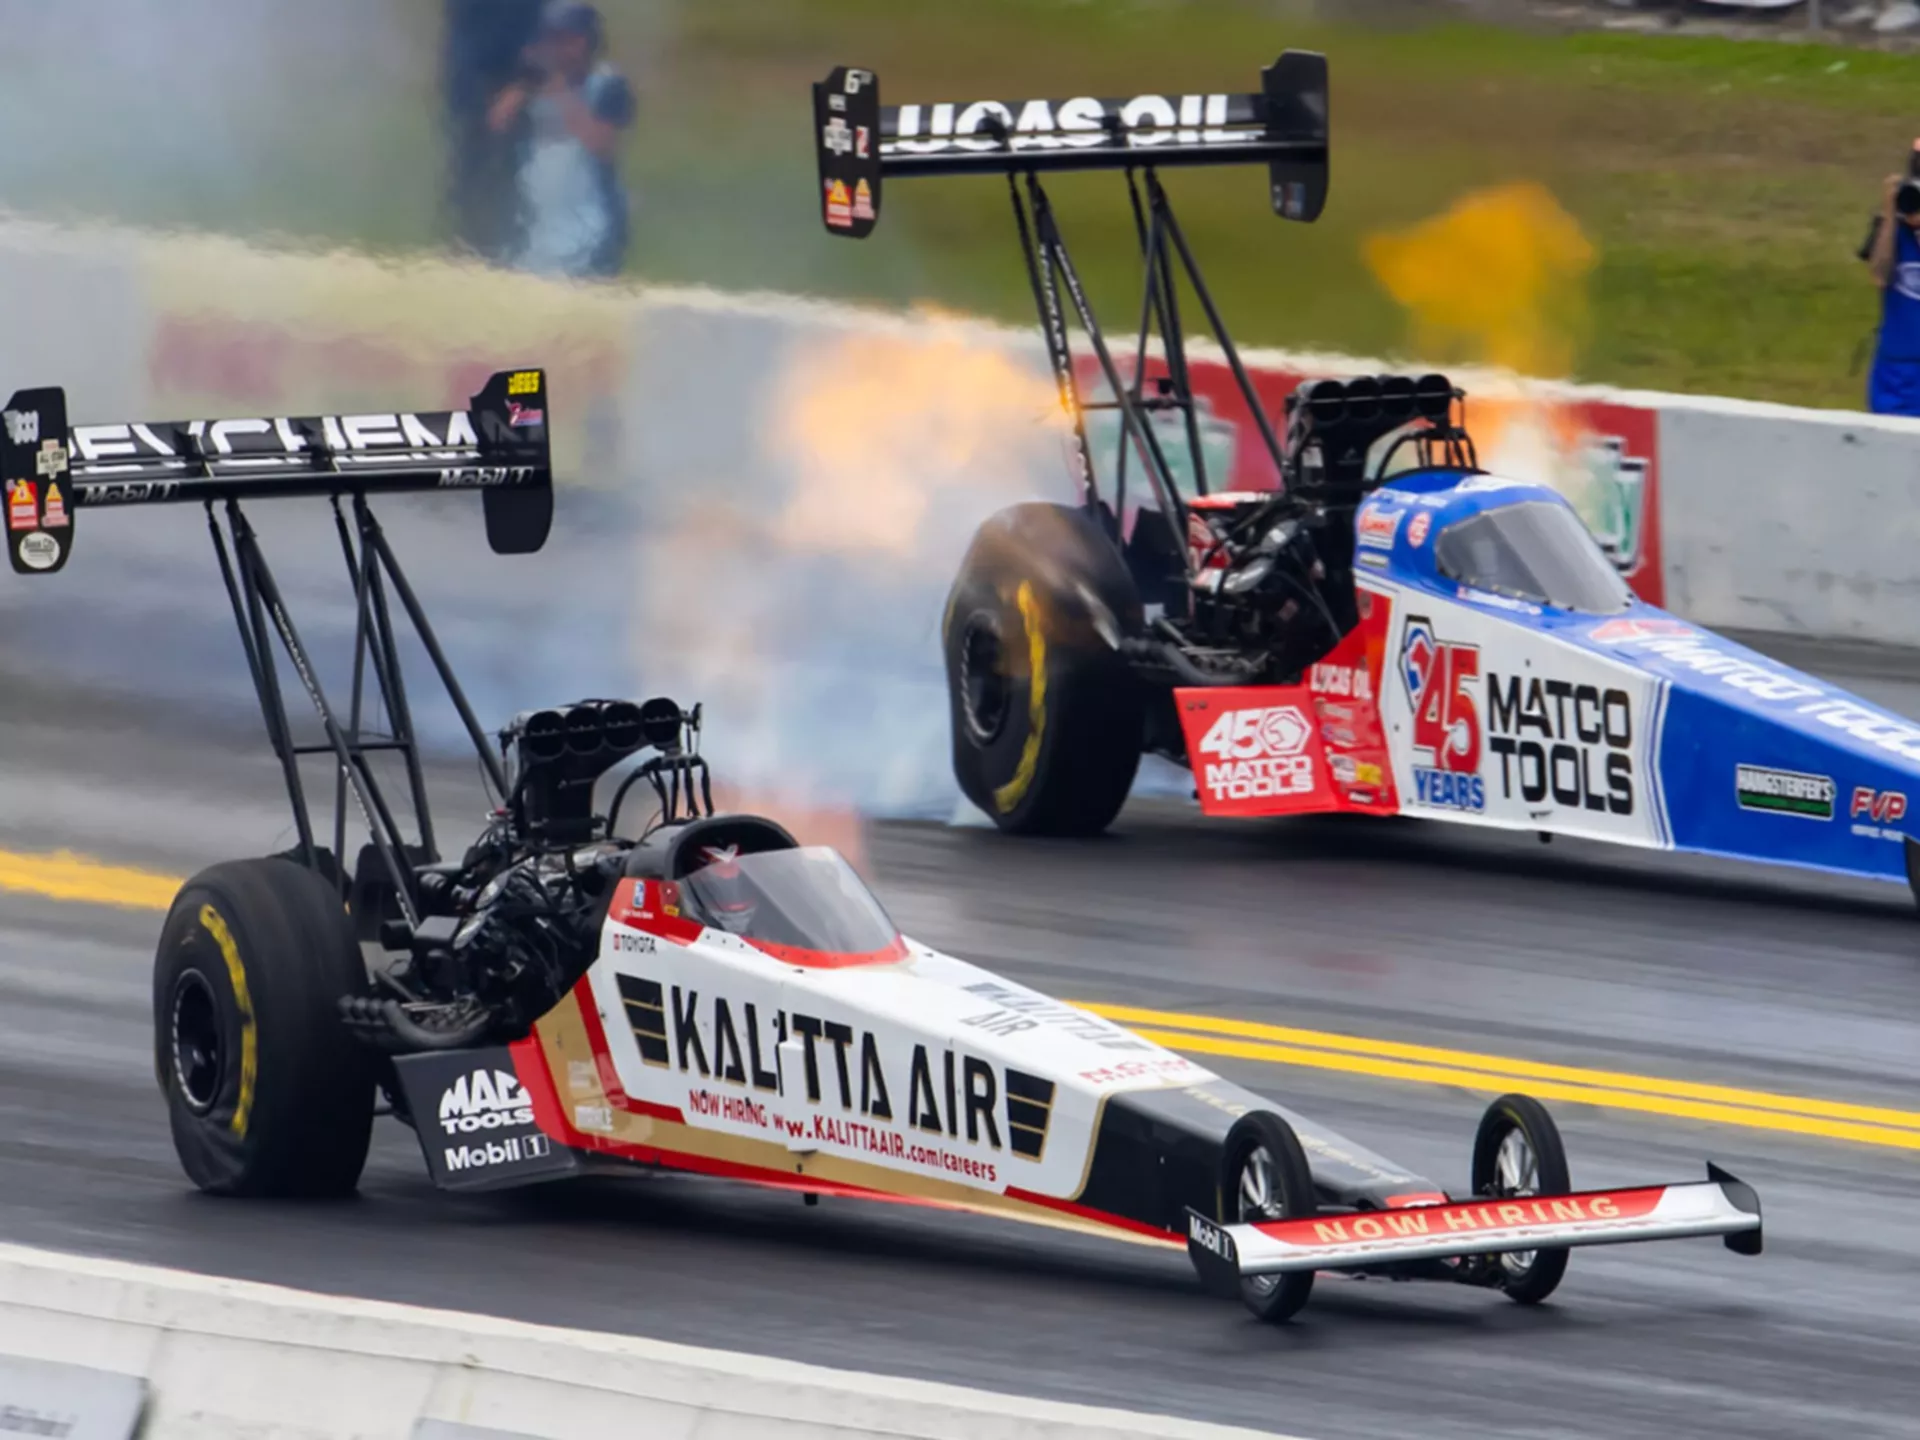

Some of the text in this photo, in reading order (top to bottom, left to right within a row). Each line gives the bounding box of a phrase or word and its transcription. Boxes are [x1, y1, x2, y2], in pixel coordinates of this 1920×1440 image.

[844, 69, 861, 94] 6
[1119, 94, 1266, 147] OIL
[68, 411, 482, 475] EVCHEM
[84, 482, 153, 503] Mobil
[438, 466, 508, 487] Mobil
[1310, 663, 1373, 700] LUCAS OIL
[1412, 644, 1481, 774] 45
[1487, 673, 1631, 749] MATCO
[1199, 708, 1264, 760] 45
[1205, 755, 1313, 785] MATCO
[1207, 774, 1314, 800] TOOLS
[1489, 736, 1634, 816] TOOLS
[1412, 765, 1486, 814] YEARS
[1850, 786, 1907, 823] FVP
[958, 1010, 1040, 1037] AIR
[672, 984, 1003, 1150] KALITTA AIR
[439, 1069, 533, 1119] MAC
[689, 1089, 720, 1117] NOW
[723, 1095, 768, 1128] HIRING
[440, 1107, 536, 1135] TOOLS
[444, 1136, 520, 1171] Mobil
[1189, 1215, 1220, 1252] Mobil
[1312, 1197, 1620, 1244] NOW HIRING
